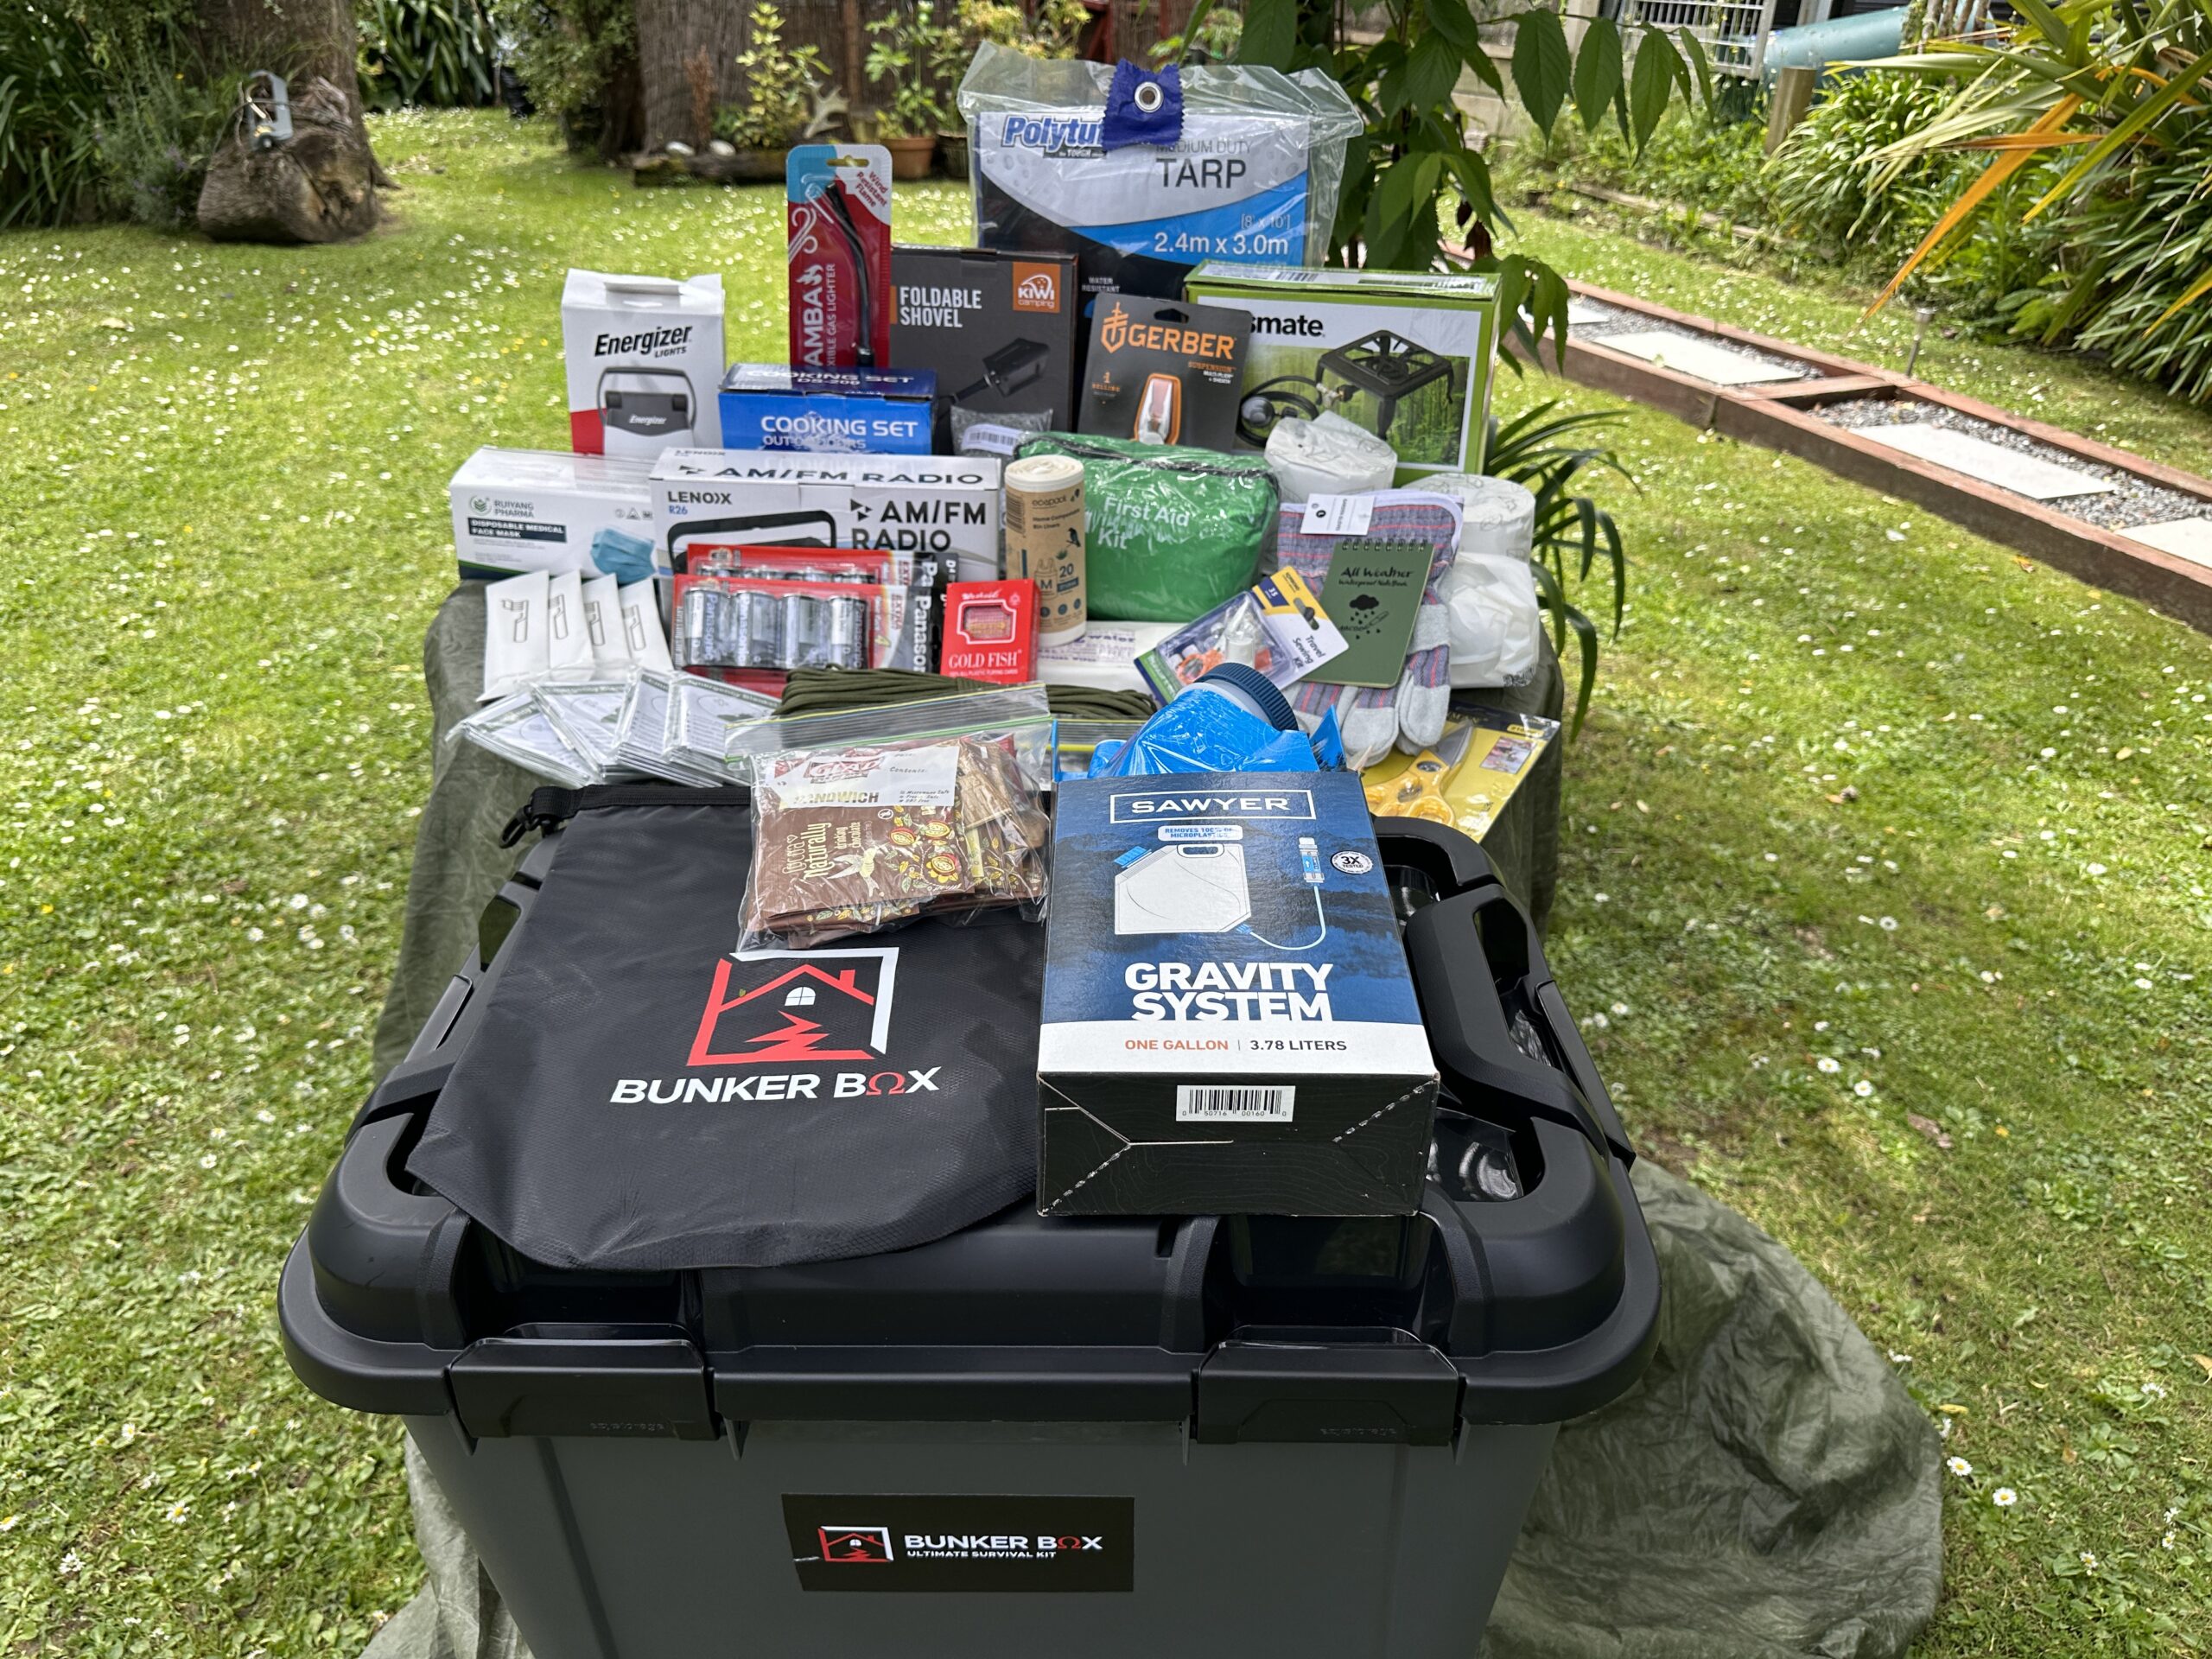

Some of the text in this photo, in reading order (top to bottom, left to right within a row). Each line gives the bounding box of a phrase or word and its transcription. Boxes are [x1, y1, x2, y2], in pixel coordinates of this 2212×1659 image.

[869, 170, 888, 194] Wind
[1156, 158, 1247, 188] TARP
[1154, 232, 1289, 256] 2.4m x 3.0m
[1082, 284, 1121, 293] RESISTANT
[1089, 276, 1114, 285] WATER
[899, 286, 982, 309] FOLDABLE
[826, 264, 836, 366] XIBLE GAS LIGHTER
[899, 307, 963, 328] SHOVEL
[802, 286, 823, 366] AMBA
[594, 326, 693, 357] Energizer
[1128, 323, 1235, 360] GERBER
[654, 346, 688, 359] LIGHTS
[746, 370, 914, 384] COOKING SET
[629, 415, 667, 426] Energizer
[760, 416, 918, 437] COOKING SET
[762, 436, 790, 448] OUT
[713, 467, 984, 485] AM/FM RADIO
[494, 508, 534, 518] PHARMA
[668, 505, 689, 515] R26
[880, 499, 987, 525] AM/FM
[1104, 496, 1190, 527] First Aid
[471, 519, 564, 534] DISPOSABLE MEDICAL
[472, 527, 494, 536] FACE
[852, 528, 951, 552] RADIO
[1097, 527, 1127, 550] Kit
[1059, 563, 1074, 578] 20
[1341, 567, 1360, 578] All
[1040, 579, 1052, 589] M
[704, 594, 719, 661] Panasonic
[913, 595, 932, 673] Panaso
[1293, 638, 1314, 664] Sewing
[1305, 635, 1326, 658] Travel
[948, 652, 1018, 668] GOLD FISH
[1291, 657, 1304, 669] Kit
[1131, 798, 1291, 813] SAWYER
[833, 826, 849, 849] drinking
[848, 822, 861, 849] chocolate
[800, 822, 835, 880] naturally
[1340, 855, 1362, 865] 3X
[1124, 962, 1334, 991] GRAVITY
[1130, 991, 1334, 1021] SYSTEM
[1125, 1039, 1347, 1051] ONE GALLON 3.78 LITERS
[609, 1073, 822, 1104] BUNKER
[905, 1535, 1029, 1549] BUNKER
[1036, 1550, 1057, 1559] KIT
